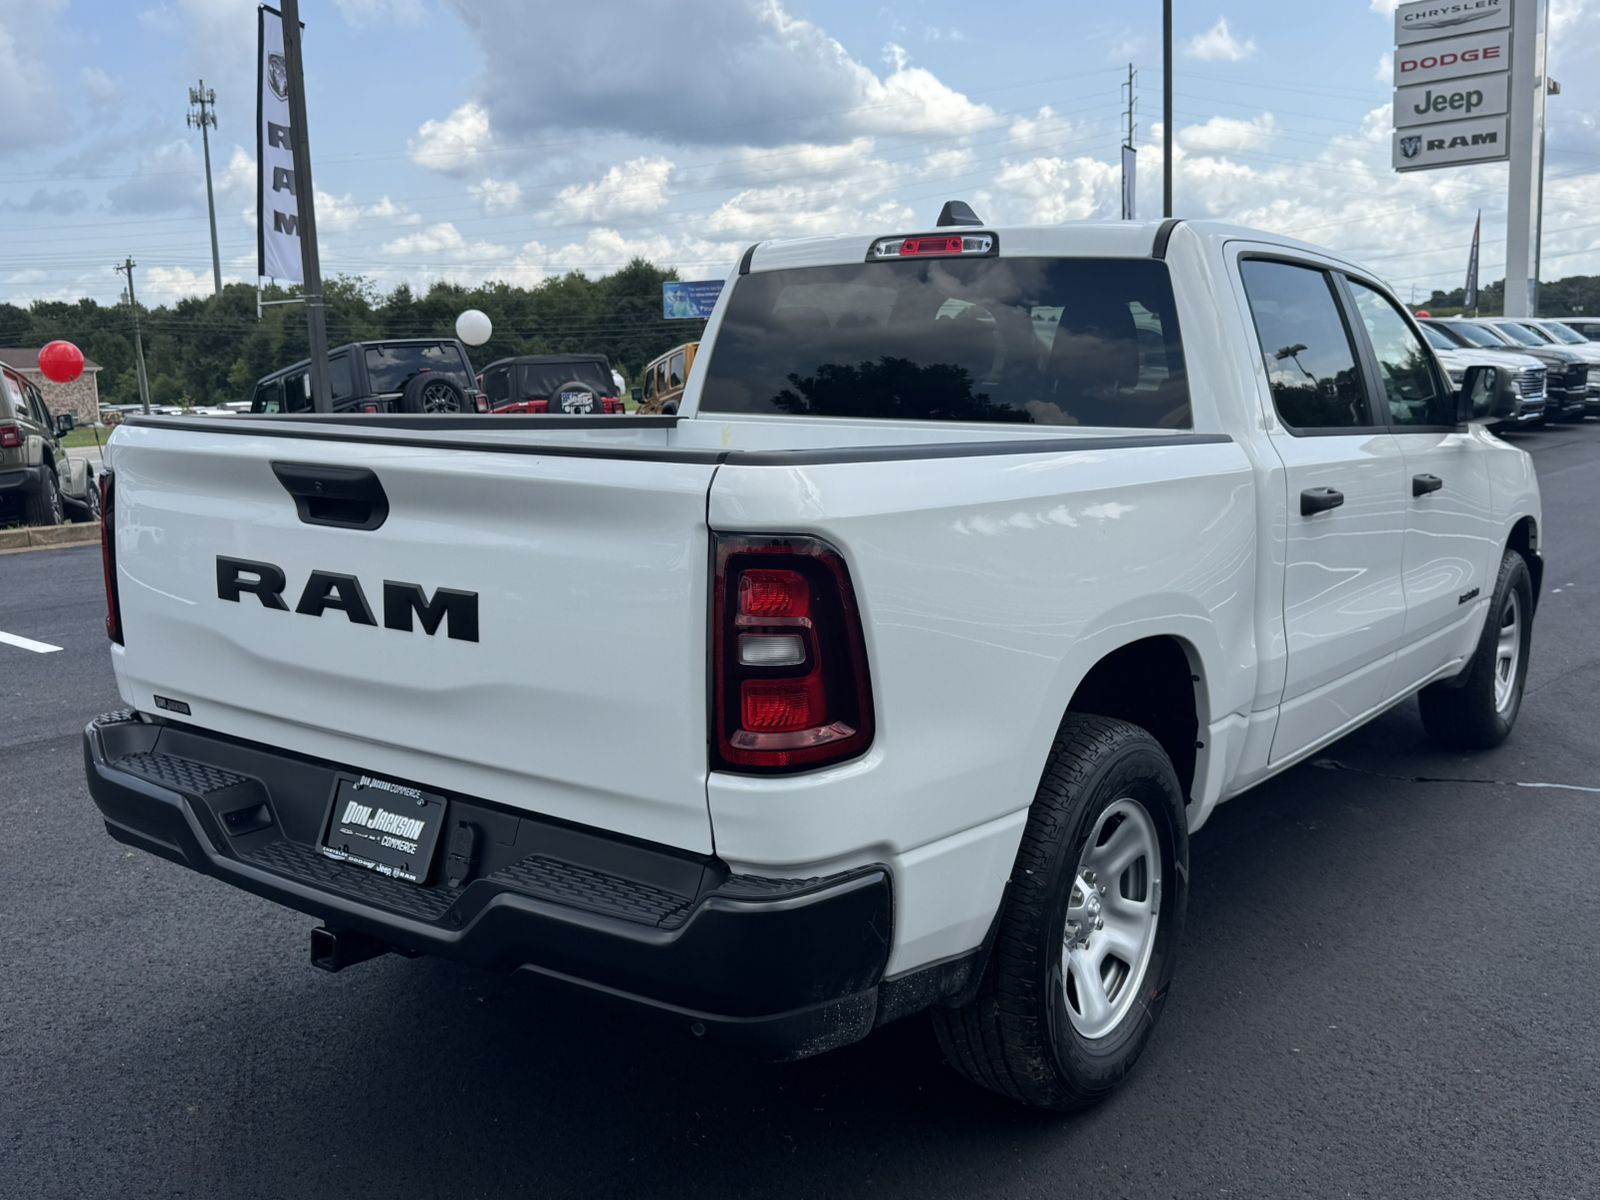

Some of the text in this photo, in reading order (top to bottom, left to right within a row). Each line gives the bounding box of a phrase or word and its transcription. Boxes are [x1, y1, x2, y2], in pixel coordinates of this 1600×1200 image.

[1404, 0, 1499, 22] CHRYSLER
[1400, 45, 1501, 73] DODGE
[1413, 89, 1484, 115] Jeep
[1426, 131, 1498, 151] RAM
[215, 554, 480, 643] RAM
[390, 783, 421, 799] COMMERCE
[380, 835, 418, 855] COMMERCE
[399, 871, 417, 881] RAM
